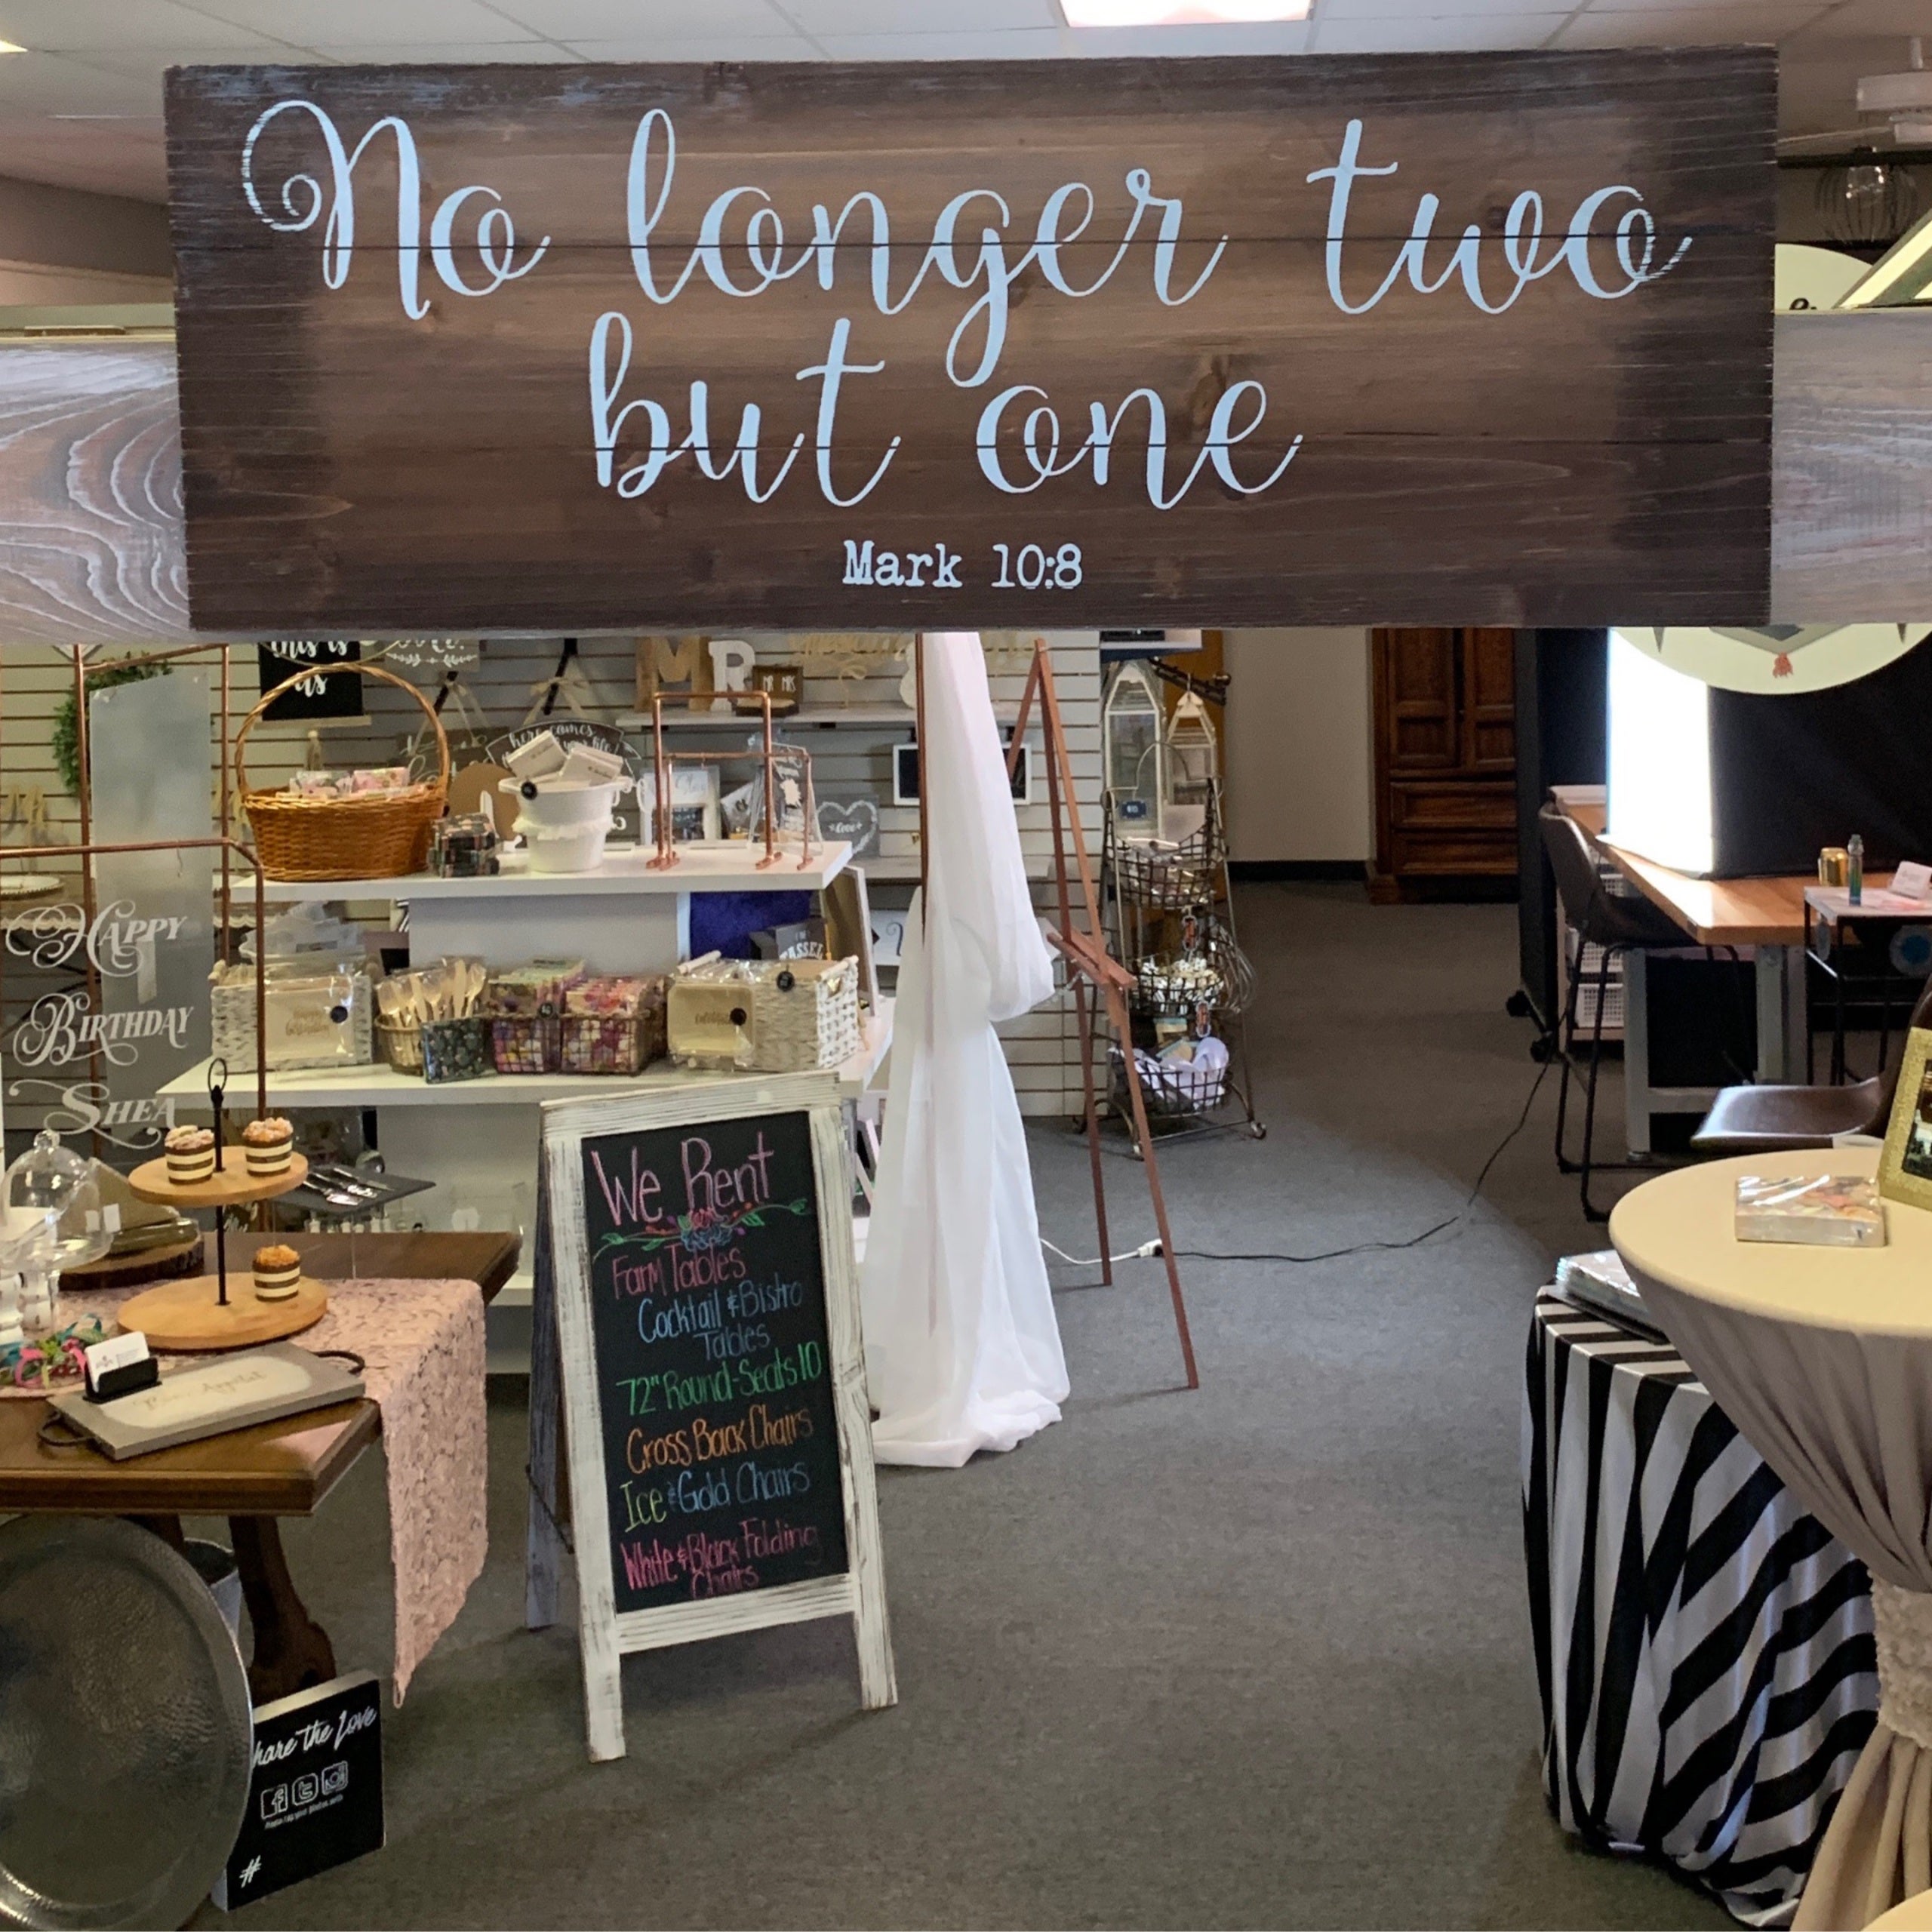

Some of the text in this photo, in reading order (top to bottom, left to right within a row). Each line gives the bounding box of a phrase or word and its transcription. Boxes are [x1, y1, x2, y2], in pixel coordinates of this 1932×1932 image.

[241, 100, 1693, 389] No longer two
[589, 312, 1304, 511] but one
[842, 540, 1084, 591] Mark 10:8
[591, 1131, 775, 1227] We Rent
[664, 1240, 747, 1293] Tables
[638, 1287, 722, 1344] Cocktail
[693, 1322, 771, 1361] Tables
[626, 1404, 814, 1475] Cross Back Chairs
[620, 1480, 667, 1534] Ice
[678, 1467, 731, 1514] Gold
[736, 1461, 811, 1504] Chairs
[620, 1538, 678, 1591] White
[687, 1531, 740, 1574] Black
[691, 1564, 760, 1599] Chairs
[253, 1706, 377, 1767] hare the Love
